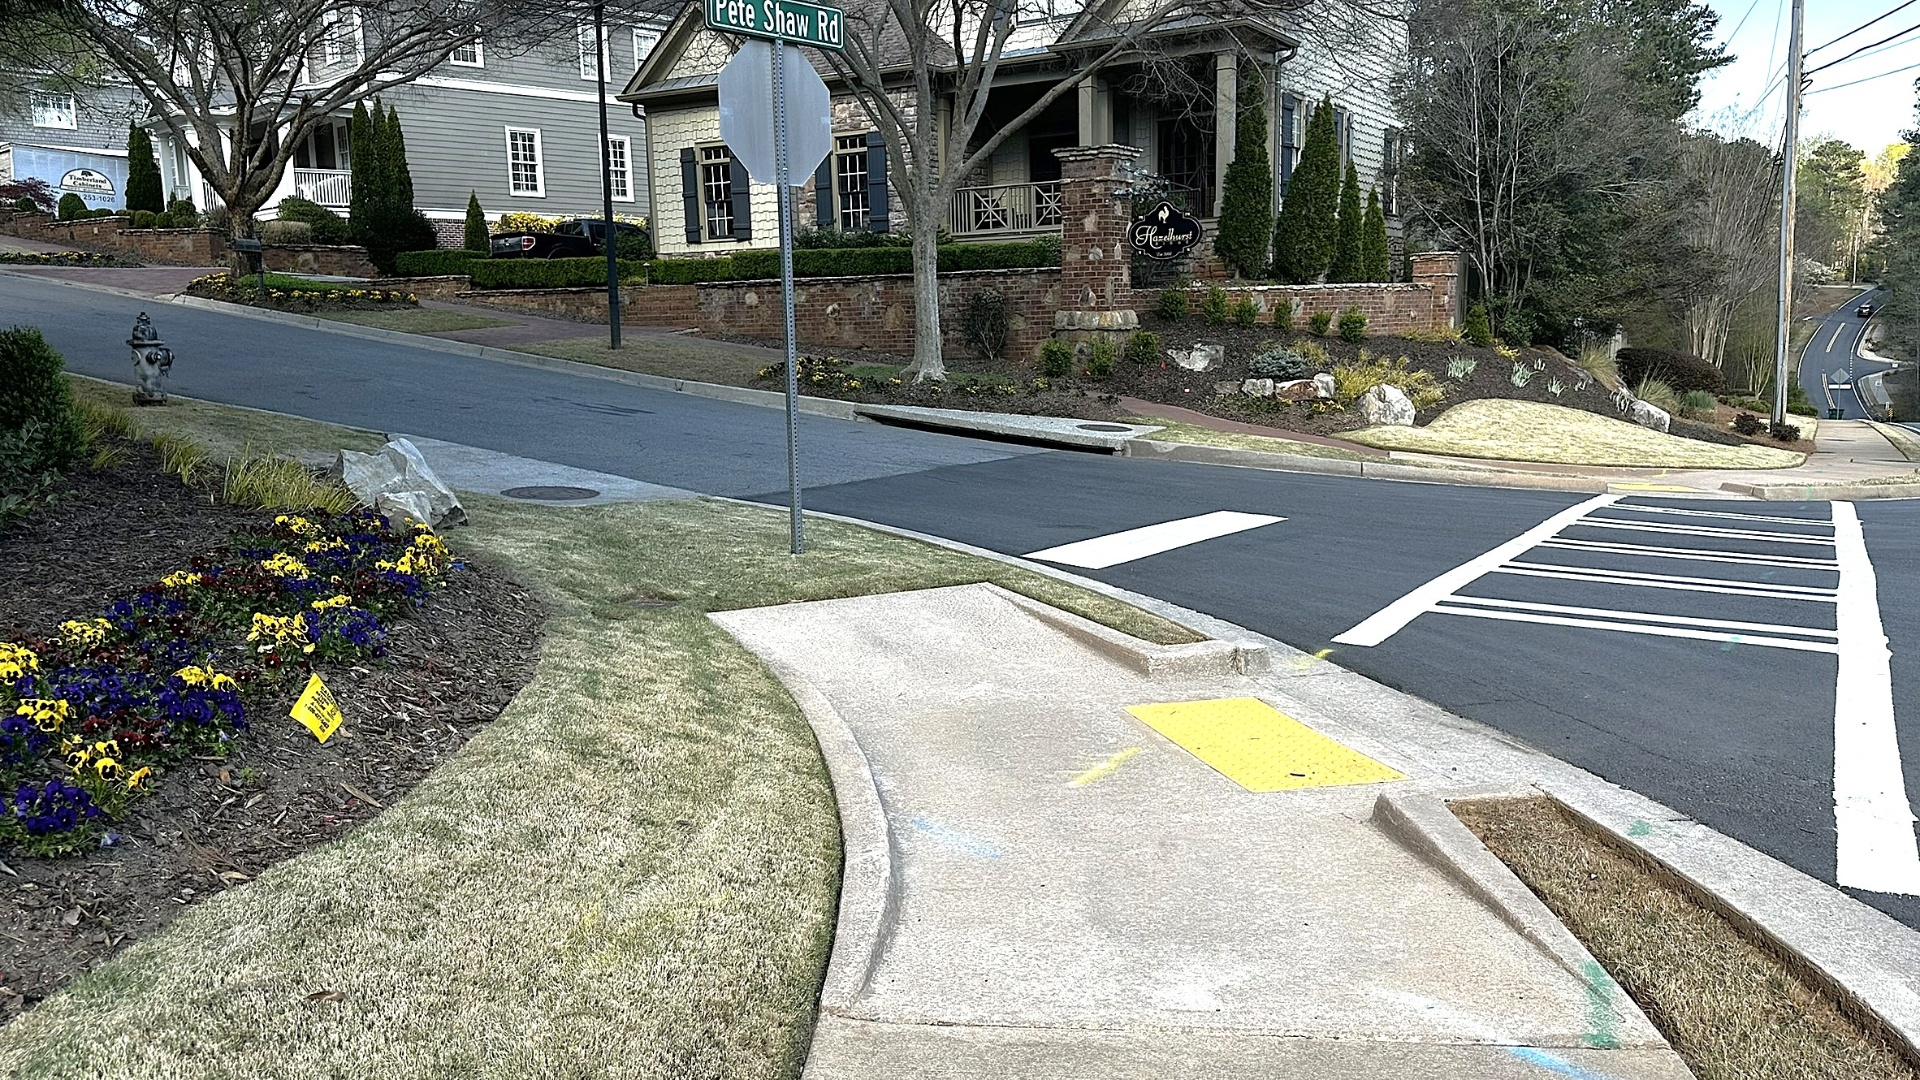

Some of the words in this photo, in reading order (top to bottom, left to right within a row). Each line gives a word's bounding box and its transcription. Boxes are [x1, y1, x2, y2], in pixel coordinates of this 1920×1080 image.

[716, 0, 755, 28] Pete
[763, 0, 809, 37] Shaw
[817, 10, 839, 43] Rd
[68, 174, 107, 184] Timberland
[72, 181, 102, 189] Cabinets
[1135, 225, 1193, 249] Hazelhurst
